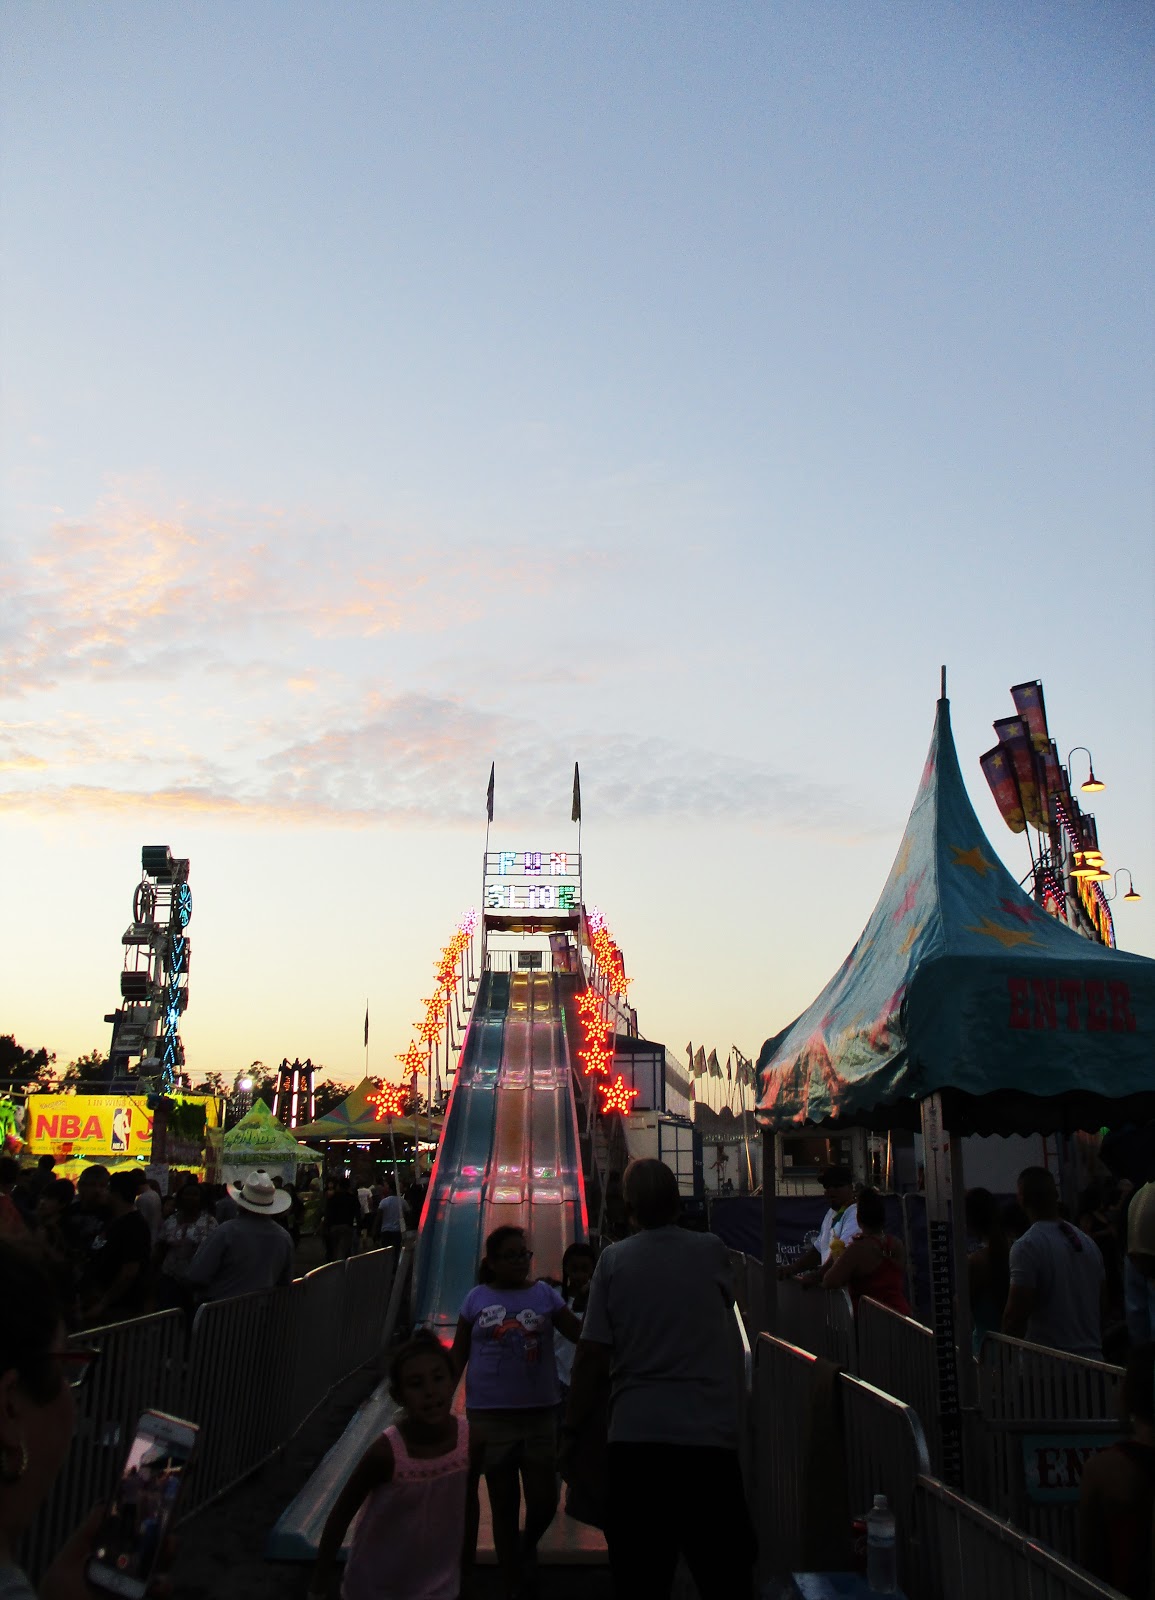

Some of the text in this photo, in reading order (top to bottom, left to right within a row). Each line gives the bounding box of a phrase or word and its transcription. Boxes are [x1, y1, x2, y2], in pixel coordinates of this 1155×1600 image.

[499, 852, 567, 875] FUN
[488, 884, 575, 909] SLIDE
[1007, 977, 1137, 1032] ENTER
[35, 1115, 105, 1141] NBA
[1035, 1447, 1103, 1488] EN
